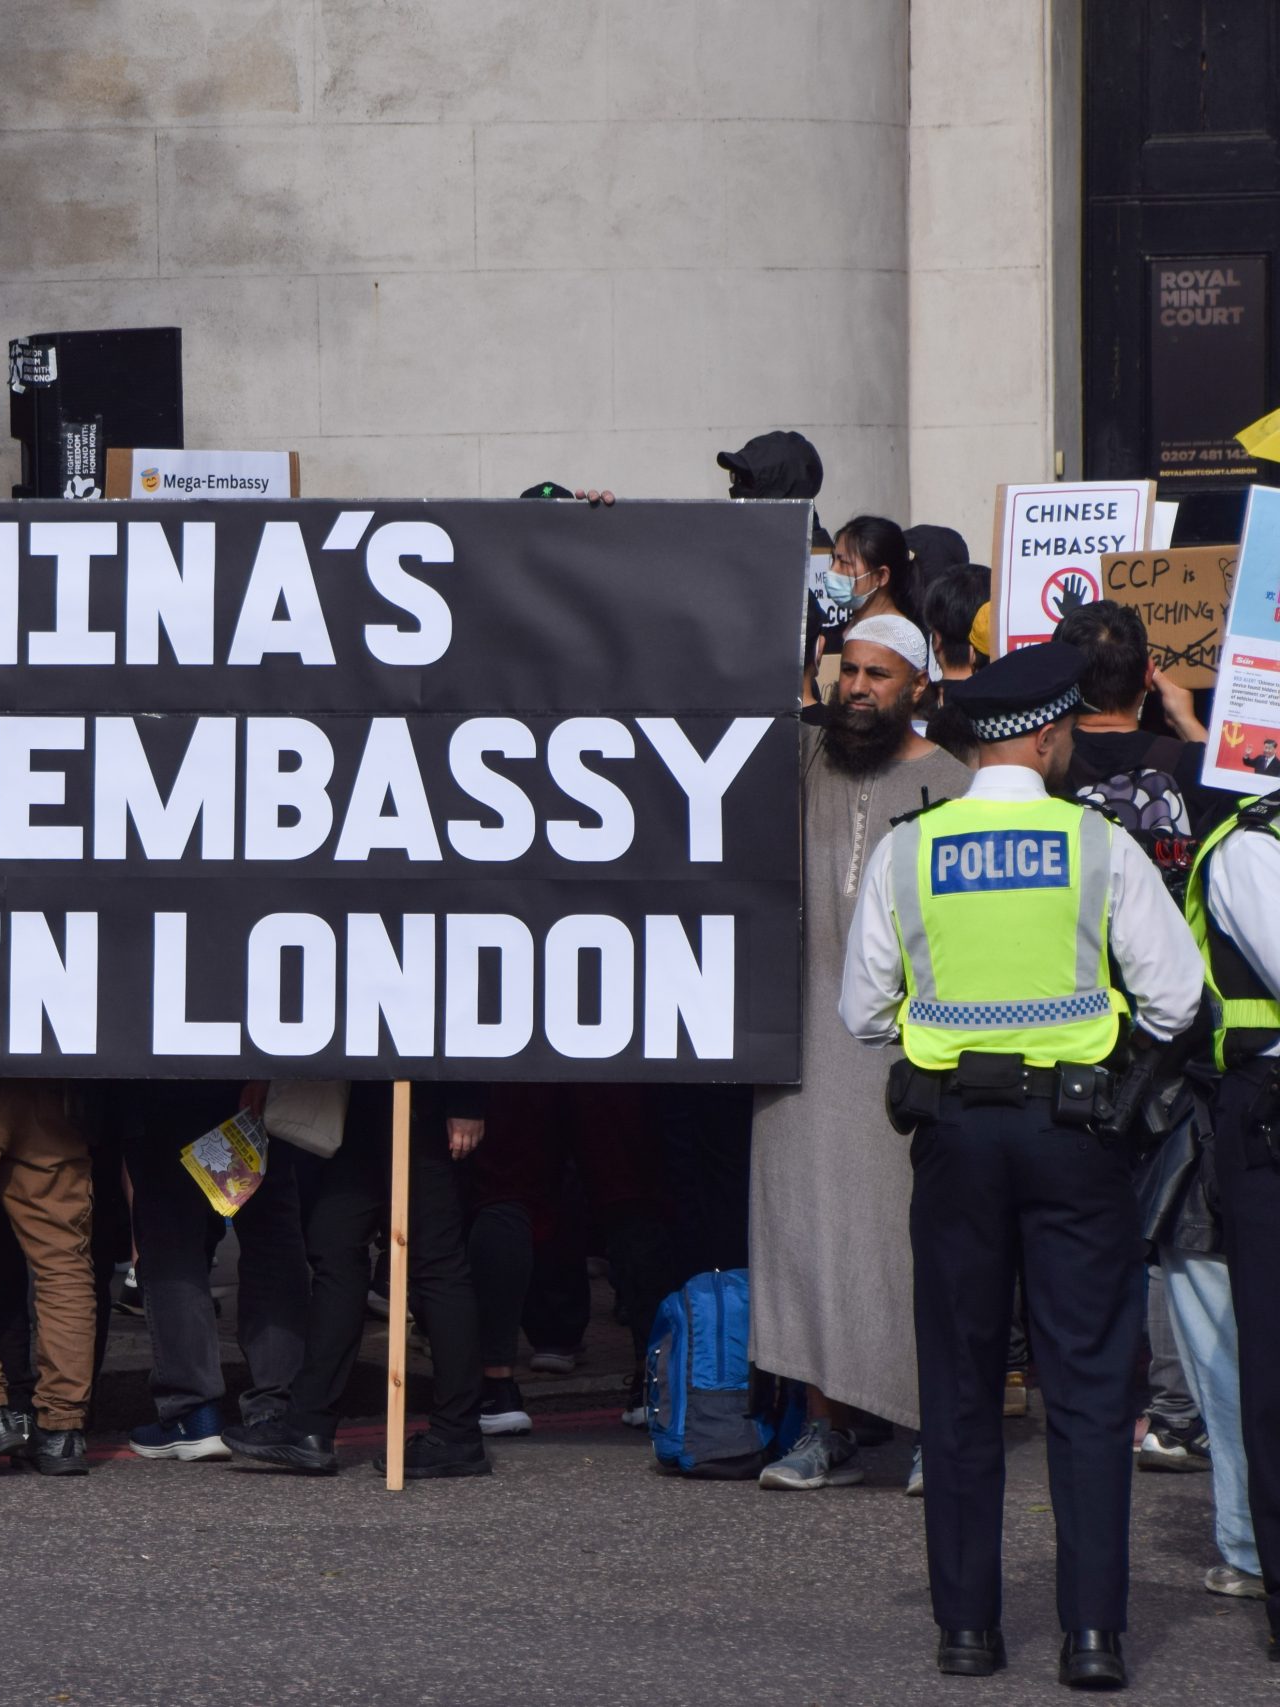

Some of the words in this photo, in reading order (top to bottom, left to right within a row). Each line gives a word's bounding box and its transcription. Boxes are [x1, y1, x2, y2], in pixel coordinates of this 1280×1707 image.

[1161, 269, 1241, 288] ROYAL
[1161, 289, 1221, 307] MINT
[1161, 306, 1244, 327] COURT
[74, 434, 82, 475] FREEDOM
[1162, 450, 1196, 462] 0207
[1199, 449, 1223, 461] 481
[1226, 448, 1249, 460] 142
[164, 474, 269, 494] Mega-Embassy
[1026, 502, 1118, 523] CHINESE
[1021, 535, 1126, 557] EMBASSY
[1108, 558, 1170, 590] CCP
[1183, 564, 1195, 584] is
[1125, 600, 1214, 625] ATCHING
[938, 839, 1062, 882] POLICE
[152, 911, 735, 1060] LONDON
